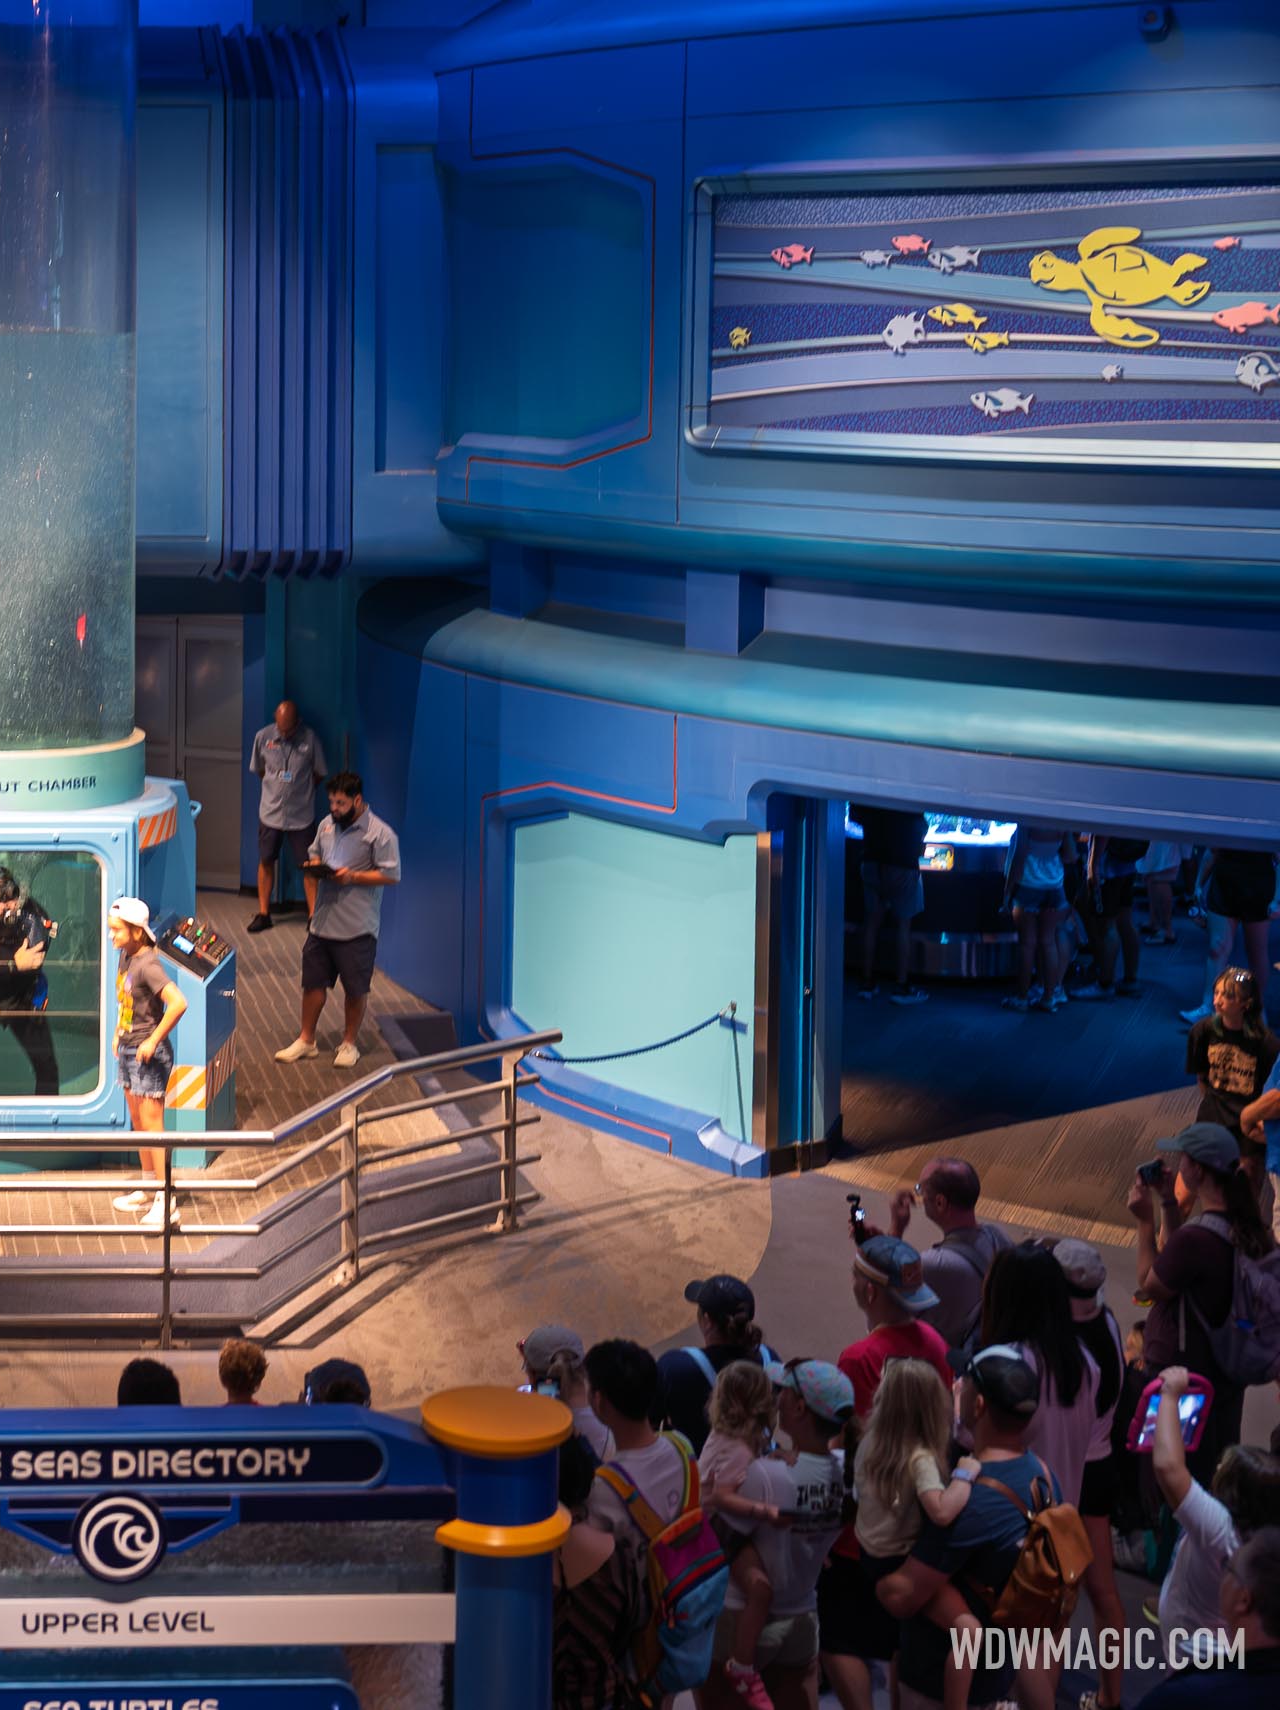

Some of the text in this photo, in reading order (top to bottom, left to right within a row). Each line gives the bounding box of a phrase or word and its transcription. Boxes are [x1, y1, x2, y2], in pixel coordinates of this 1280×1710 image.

[28, 775, 97, 792] CHAMBER
[11, 1449, 102, 1480] SEAS
[112, 1447, 311, 1478] DIRECTORY
[21, 1611, 215, 1635] UPPER LEVEL
